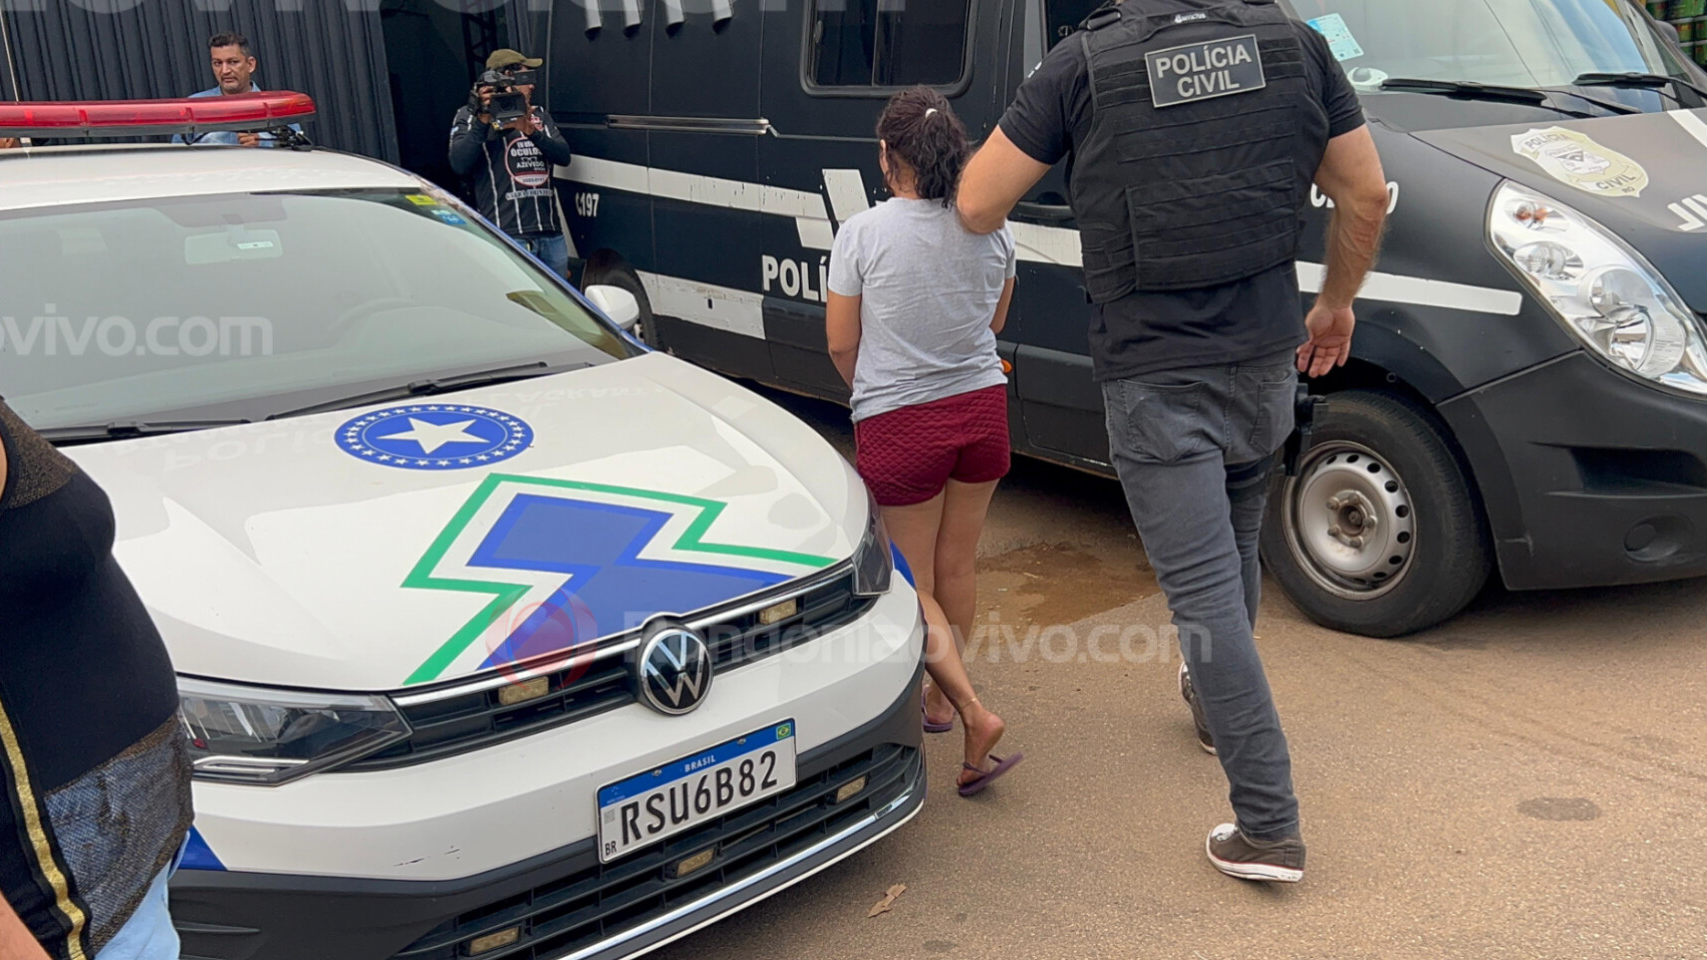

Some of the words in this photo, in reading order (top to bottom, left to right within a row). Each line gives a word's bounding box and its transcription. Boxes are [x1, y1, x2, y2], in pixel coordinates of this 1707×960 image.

[1155, 44, 1253, 79] POLÍCIA
[1177, 70, 1240, 98] CIVIL
[1596, 174, 1636, 190] CIVIL
[762, 254, 828, 303] POLÍ
[684, 754, 716, 773] BRASIL
[620, 750, 778, 846] RSU6B82
[604, 840, 617, 856] BR
